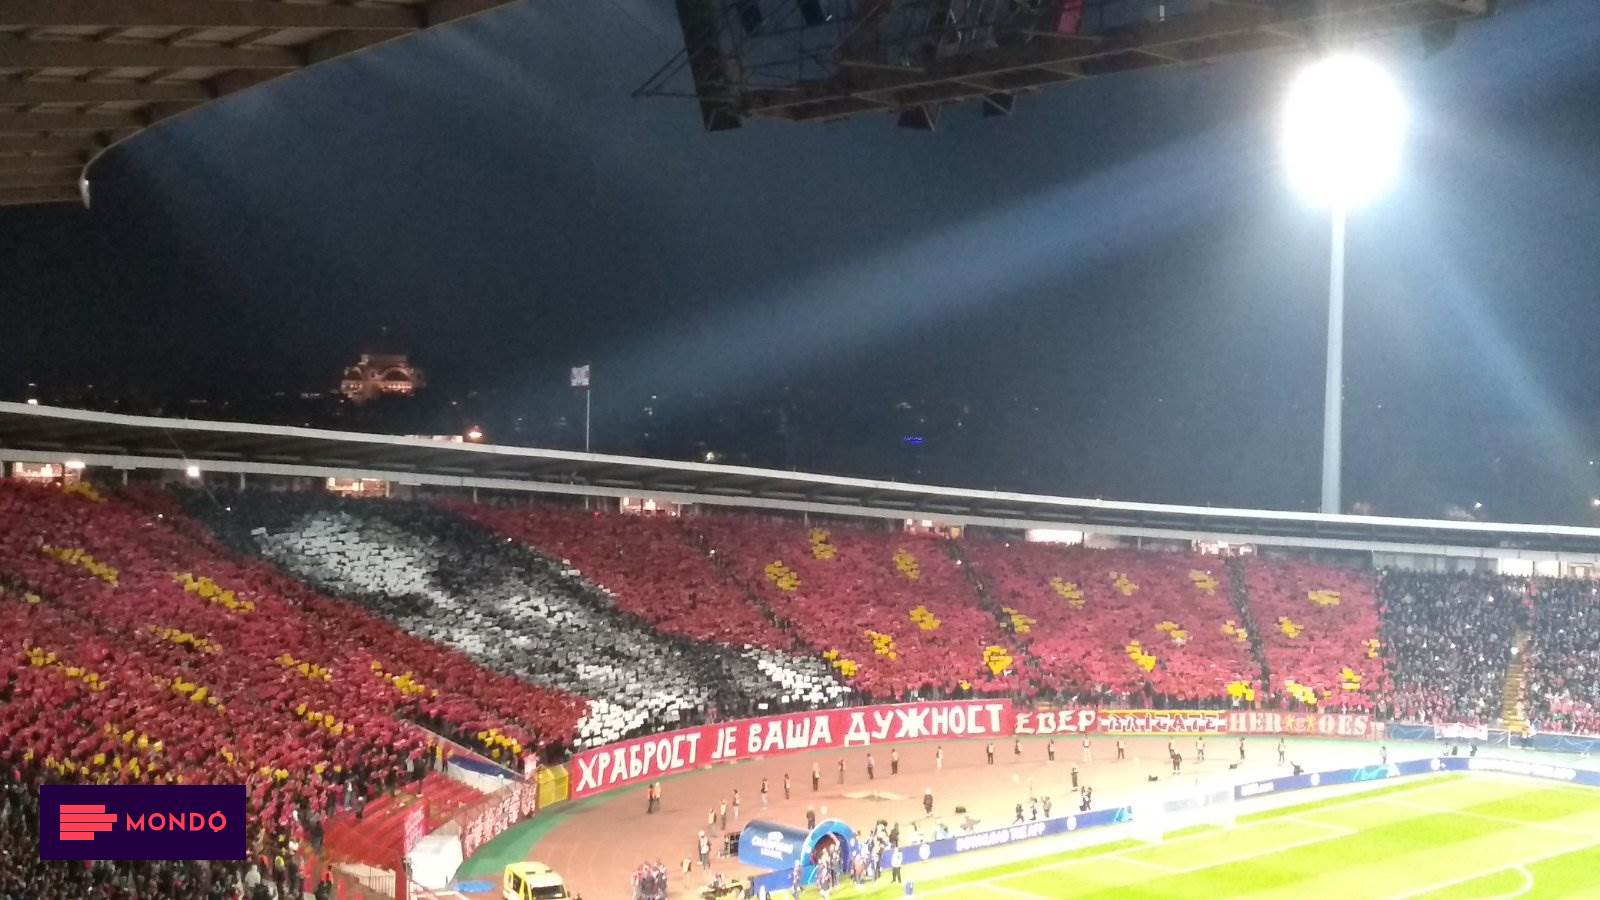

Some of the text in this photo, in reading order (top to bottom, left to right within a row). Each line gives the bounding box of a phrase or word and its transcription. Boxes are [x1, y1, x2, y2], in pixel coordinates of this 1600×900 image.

[576, 731, 701, 792] ХРАБРОСТ
[748, 715, 832, 753] ВАША
[844, 703, 1003, 747] ДУЖНОСТ
